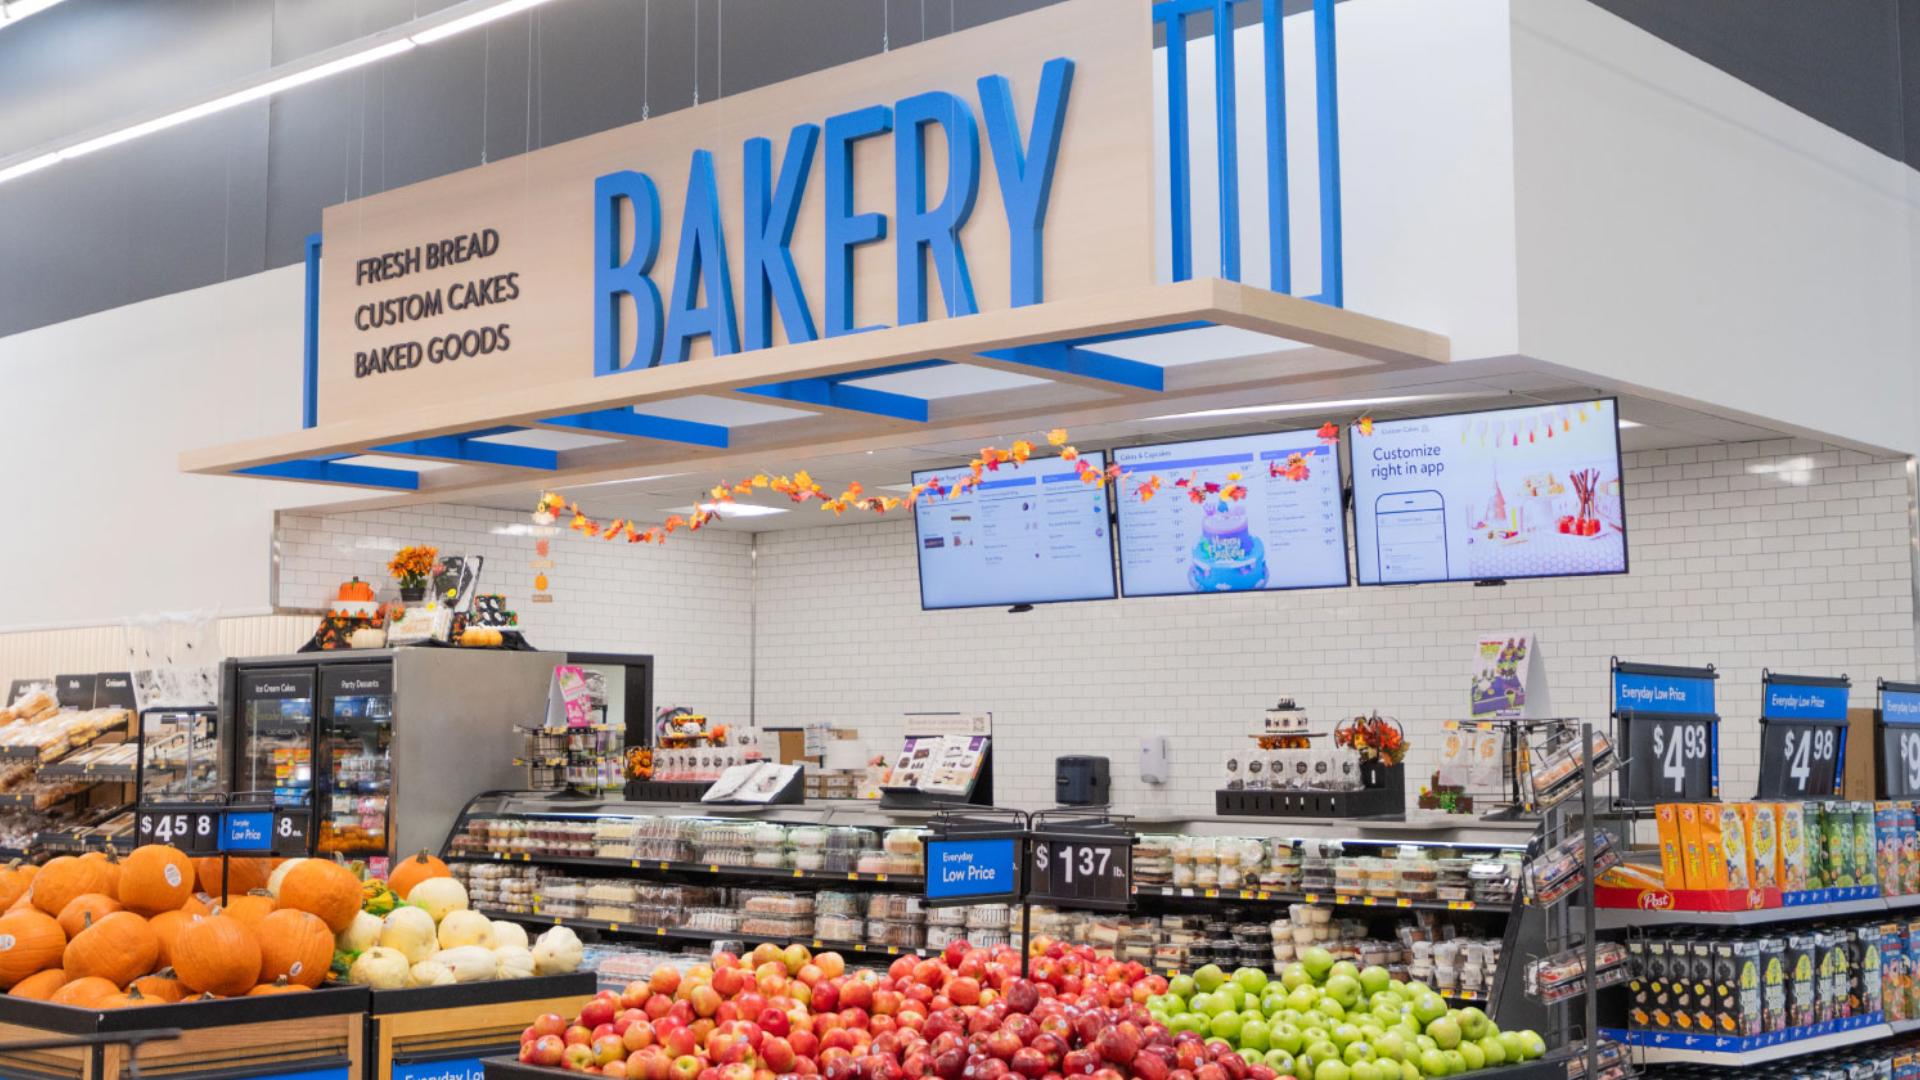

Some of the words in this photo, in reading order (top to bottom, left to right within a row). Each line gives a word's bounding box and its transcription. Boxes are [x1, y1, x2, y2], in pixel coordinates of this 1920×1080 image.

[594, 57, 1075, 378] BAKERY
[355, 247, 420, 286] FRESH
[426, 229, 499, 270] BREAD
[355, 288, 442, 331] CUSTOM
[447, 272, 520, 311] CAKES
[354, 341, 422, 379] BAKED
[427, 324, 510, 364] GOODS
[1372, 444, 1441, 462] Customize
[1371, 463, 1403, 481] right
[1405, 461, 1418, 475] in
[1420, 462, 1444, 477] app
[255, 685, 263, 693] Ice
[264, 683, 280, 693] Cream
[281, 683, 296, 692] Cakes
[341, 680, 355, 689] Party
[356, 679, 379, 688] Desserts
[1621, 684, 1654, 702] Everyday
[1654, 685, 1668, 700] Low
[1669, 687, 1686, 701] Price
[1772, 693, 1798, 709] Everyday
[1798, 696, 1810, 707] Low
[1811, 696, 1825, 708] Price
[231, 829, 243, 841] Low
[244, 829, 261, 840] Price
[943, 851, 973, 863] Everyday
[943, 867, 965, 882] Low
[968, 865, 995, 880] Price
[1113, 866, 1125, 878] lb.
[1643, 892, 1669, 910] Post
